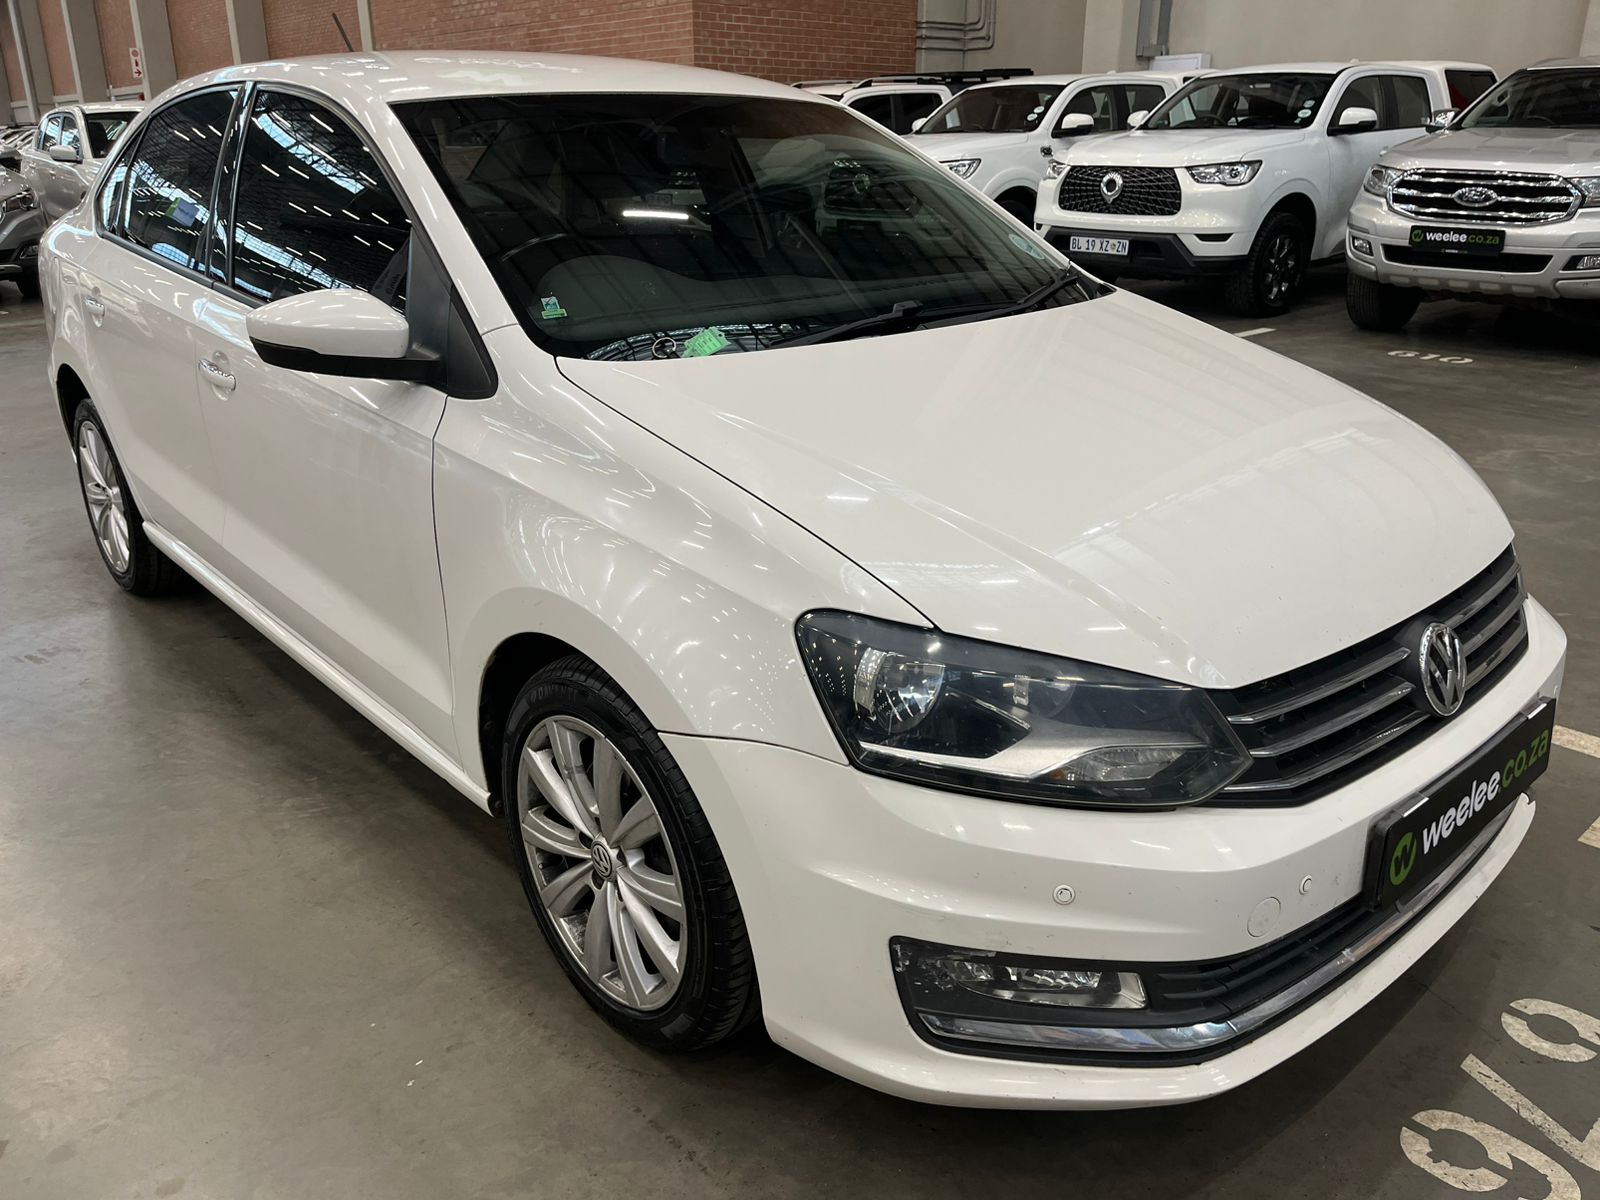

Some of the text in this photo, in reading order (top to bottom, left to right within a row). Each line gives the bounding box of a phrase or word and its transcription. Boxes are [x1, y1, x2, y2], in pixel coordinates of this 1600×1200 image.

[1071, 237, 1127, 253] BL 19 XZ ZN
